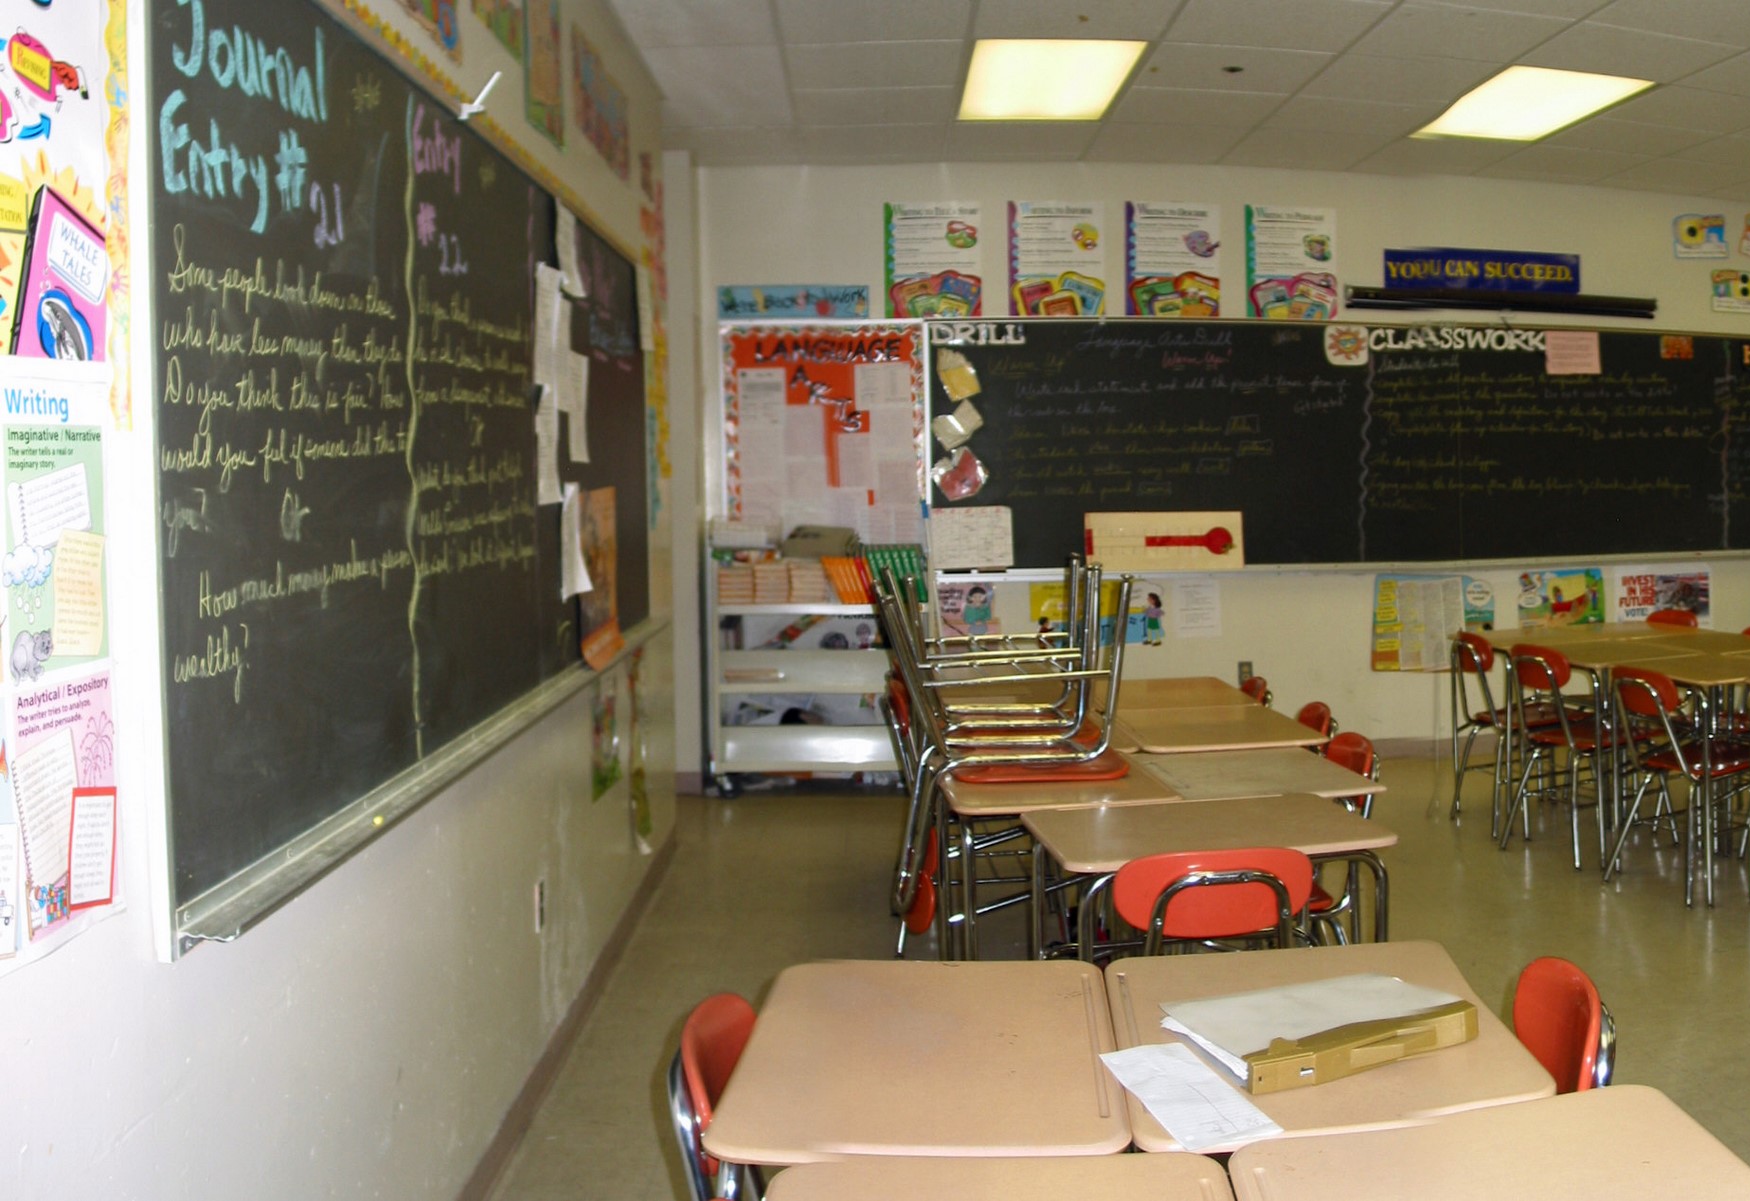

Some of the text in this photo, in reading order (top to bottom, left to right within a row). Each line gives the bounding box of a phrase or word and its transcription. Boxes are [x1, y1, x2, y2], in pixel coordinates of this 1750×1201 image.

[172, 0, 328, 123] Journal
[413, 103, 462, 195] Entry
[159, 89, 344, 249] Entry # 21
[61, 221, 99, 266] WHALE
[62, 249, 92, 286] TALES
[168, 223, 218, 292] Some
[218, 256, 272, 314] people
[1444, 258, 1480, 278] CAN
[1483, 261, 1574, 282] SUCCEED.
[164, 305, 202, 350] who
[206, 308, 244, 355] have
[249, 316, 279, 356] less
[930, 322, 1026, 346] DRILL
[754, 338, 903, 364] LANGUAGE
[4, 387, 69, 423] Writing
[164, 355, 194, 405] Do
[198, 381, 233, 436] you
[235, 367, 284, 411] think
[290, 371, 320, 411] this
[7, 428, 59, 444] Imaginative
[65, 429, 101, 442] Narrative
[8, 446, 19, 456] The
[20, 446, 38, 456] writer
[38, 446, 51, 456] tells
[56, 446, 67, 456] real
[68, 448, 74, 456] or
[8, 459, 56, 471] imaginary story.
[161, 432, 212, 471] would
[216, 442, 255, 494] you
[258, 427, 290, 483] feel
[289, 432, 305, 481] if
[199, 569, 238, 619] How
[241, 560, 286, 605] much
[174, 622, 250, 702] wealthy?
[17, 686, 60, 709] Analytical
[67, 677, 108, 697] Expository
[17, 715, 29, 725] The
[29, 711, 47, 723] writer
[48, 708, 61, 718] tries
[42, 719, 54, 730] and
